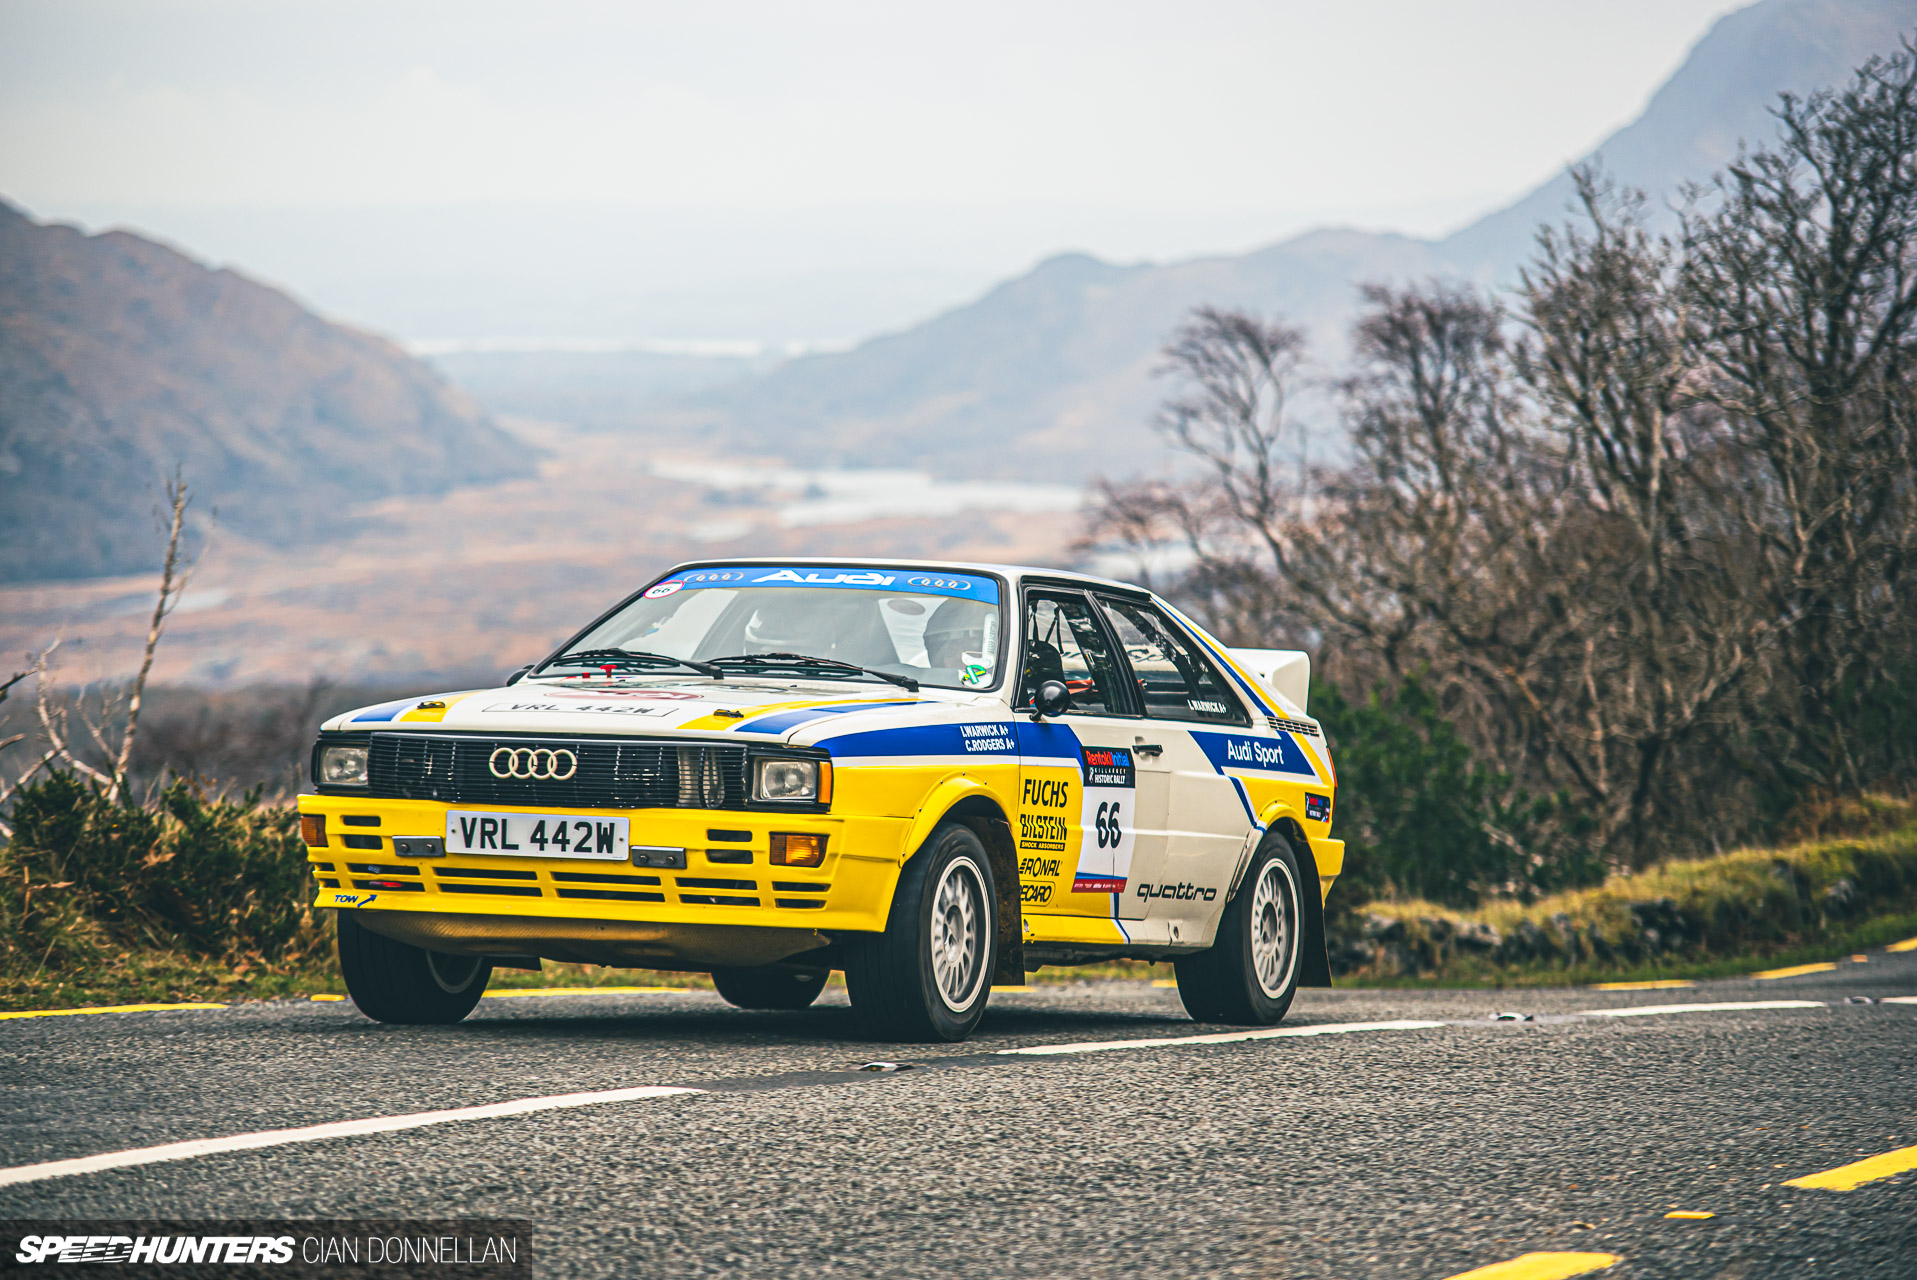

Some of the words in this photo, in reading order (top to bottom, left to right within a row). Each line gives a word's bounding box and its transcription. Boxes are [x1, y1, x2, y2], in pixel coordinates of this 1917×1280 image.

[751, 569, 897, 587] Audi
[652, 586, 672, 595] 66
[576, 705, 655, 714] 442W
[965, 738, 1006, 752] C.RODGERS
[1227, 739, 1253, 761] Audi
[1254, 741, 1285, 768] Sport
[1094, 774, 1113, 784] HISTORIC
[1113, 774, 1126, 784] RALLY
[1022, 779, 1069, 808] FUCHS
[1020, 814, 1068, 841] BILSTEIN
[1095, 801, 1123, 849] 66
[459, 816, 519, 851] VRL
[529, 818, 615, 855] 442W
[1021, 841, 1037, 849] SHOCK
[1038, 842, 1064, 850] ABSORBERS
[334, 894, 359, 904] TOW
[1020, 884, 1052, 903] ECARO
[1136, 881, 1218, 903] quattro
